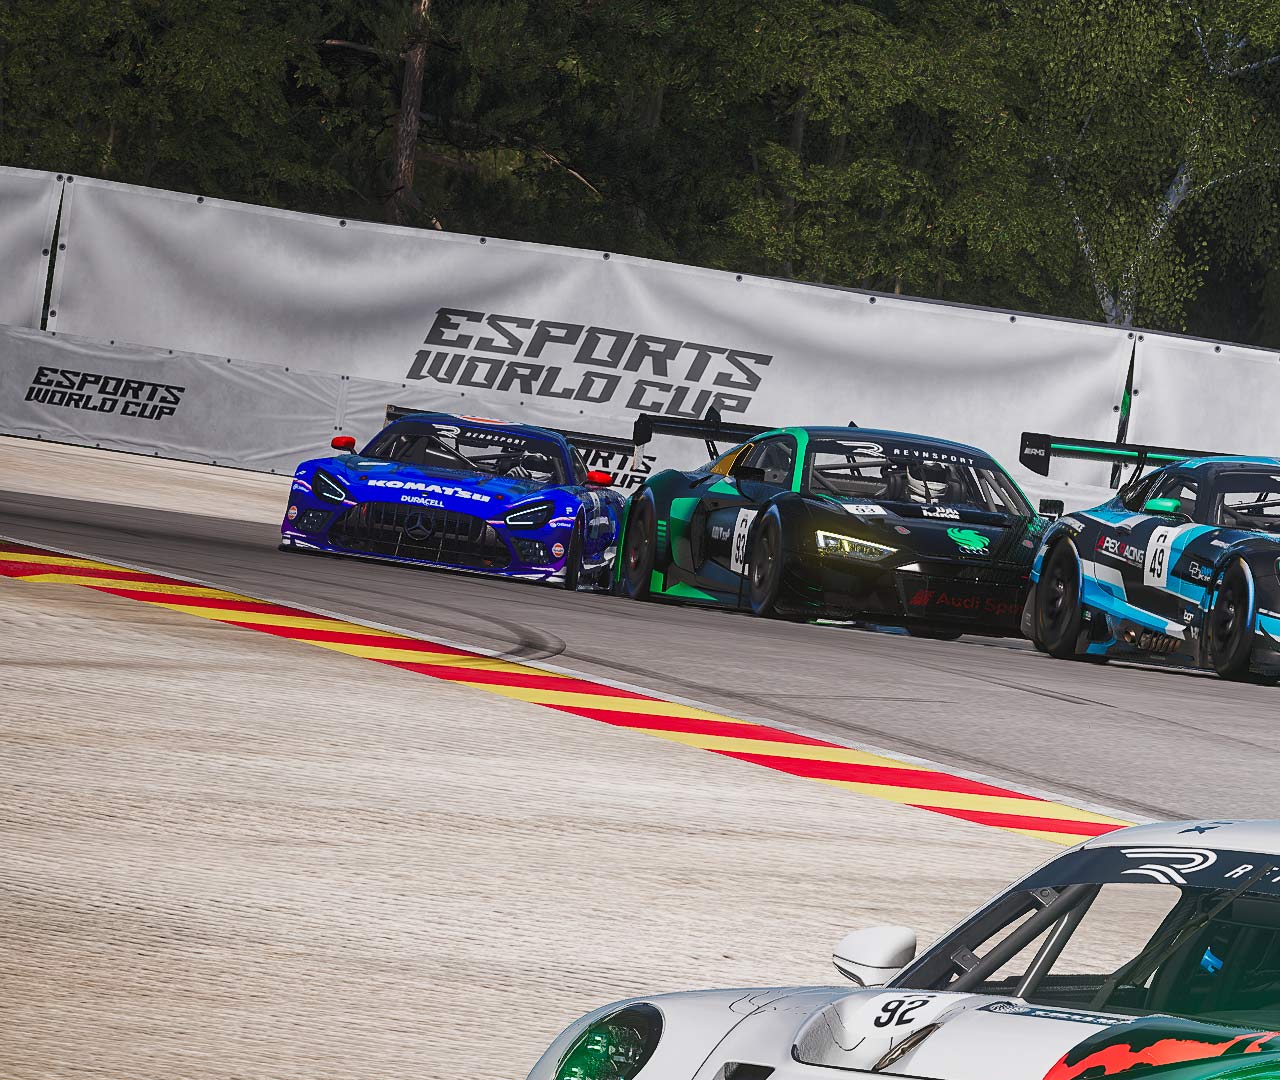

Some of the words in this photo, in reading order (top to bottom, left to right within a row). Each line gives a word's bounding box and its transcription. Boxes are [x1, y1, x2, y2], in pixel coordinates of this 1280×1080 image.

[423, 307, 773, 392] ESPORTS
[32, 366, 185, 405] ESPORTS
[406, 349, 622, 404] WORLD
[625, 379, 752, 419] CUP
[25, 386, 119, 413] WORLD
[120, 400, 177, 421] CUP
[465, 432, 527, 446] RENNSPORT
[894, 448, 974, 465] RENNSPORT
[367, 479, 491, 503] KOMATSU
[400, 494, 445, 508] DURACELL
[1149, 547, 1165, 579] 49
[935, 591, 980, 609] Audi
[874, 999, 931, 1028] 92
